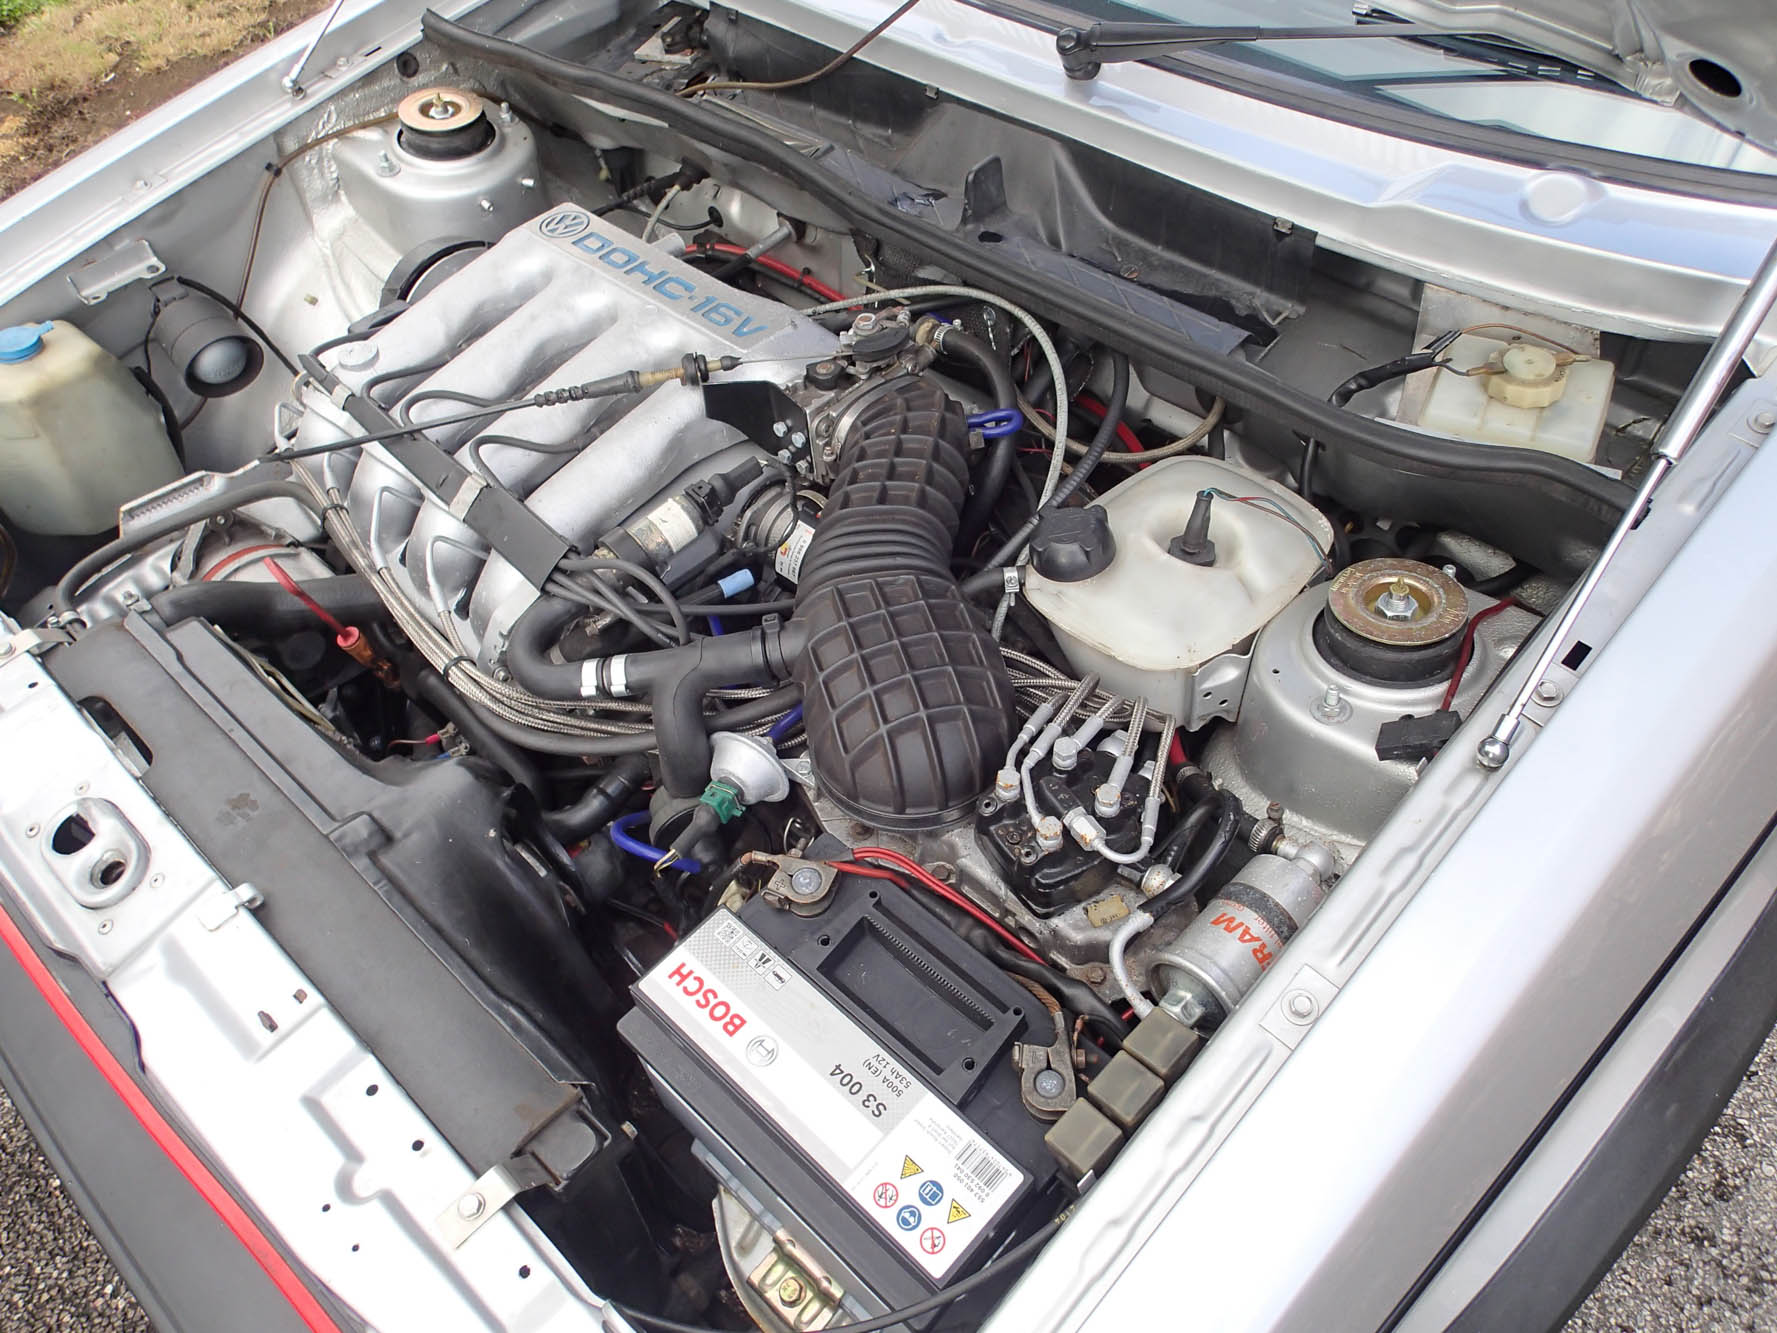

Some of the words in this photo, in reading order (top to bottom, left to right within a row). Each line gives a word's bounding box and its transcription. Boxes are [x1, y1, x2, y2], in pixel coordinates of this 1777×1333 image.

[667, 962, 748, 1038] BOSCH
[862, 1058, 882, 1078] (EN)
[872, 1053, 890, 1069] 12V
[829, 1063, 863, 1096] 004
[882, 1075, 904, 1098] 500A
[890, 1067, 912, 1089] 53Ah
[862, 1093, 887, 1118] S3
